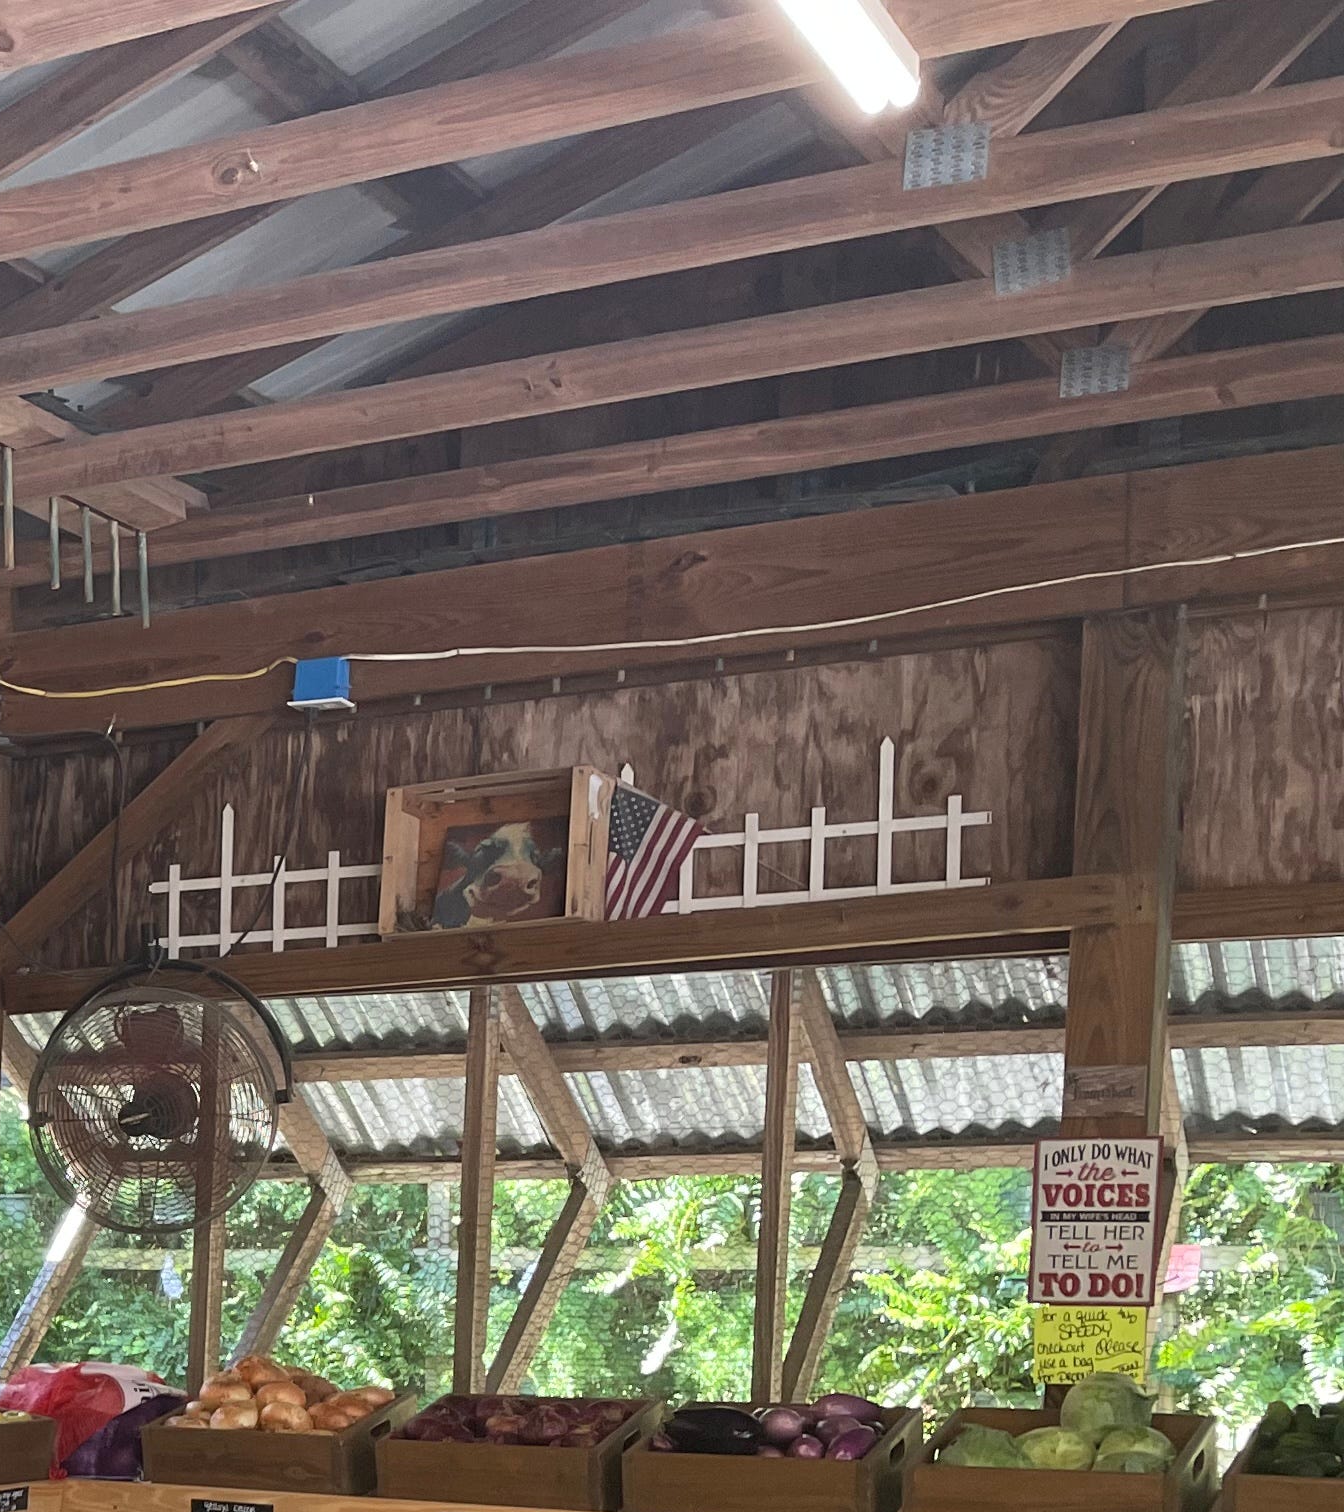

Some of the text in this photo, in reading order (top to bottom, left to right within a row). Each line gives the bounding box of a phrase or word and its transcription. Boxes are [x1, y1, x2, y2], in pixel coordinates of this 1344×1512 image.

[1044, 1143, 1154, 1171] I ONLY DO WHAT
[1077, 1162, 1116, 1182] the
[1042, 1183, 1150, 1208] VOICES
[1050, 1212, 1137, 1222] IN MY WIFE'S HEAD
[1045, 1225, 1145, 1241] TELL HER
[1082, 1241, 1102, 1253] to
[1048, 1254, 1139, 1270] TELL ME
[1039, 1272, 1144, 1298] TO DO!
[1063, 1311, 1071, 1322] a
[1058, 1323, 1113, 1340] SPEEDY
